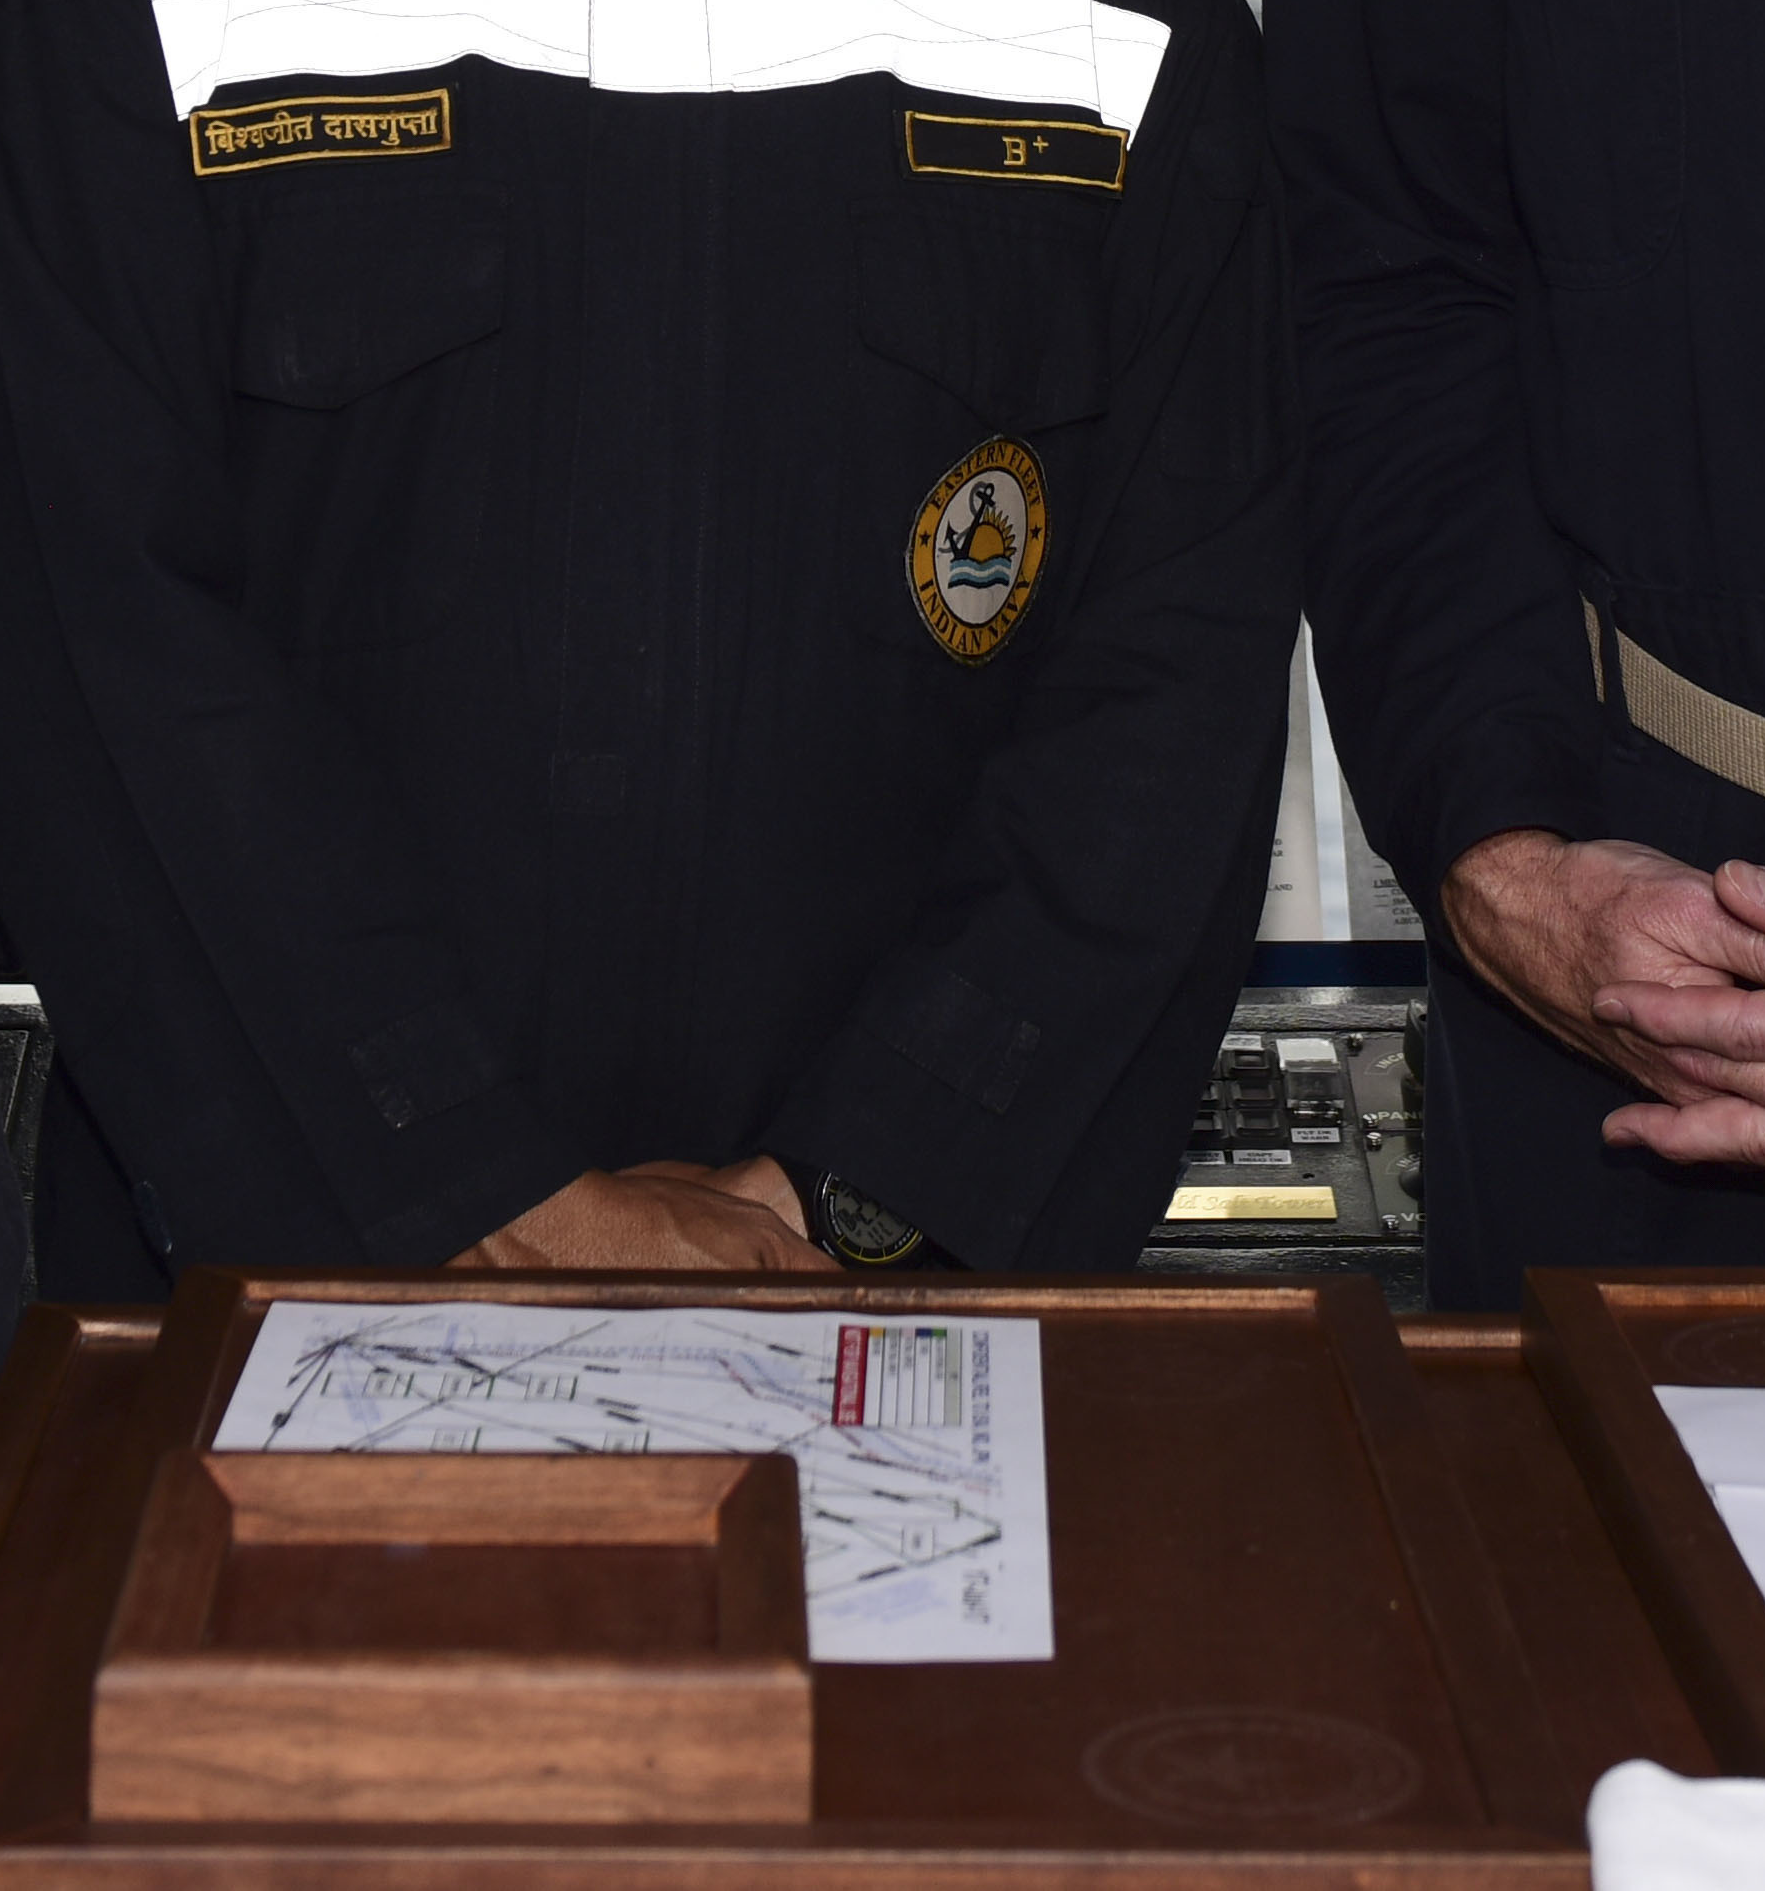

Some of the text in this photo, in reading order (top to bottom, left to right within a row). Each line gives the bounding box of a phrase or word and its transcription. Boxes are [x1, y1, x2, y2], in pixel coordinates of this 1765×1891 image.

[929, 443, 1043, 512] EASTERN FLEET
[918, 577, 984, 655] INDIAN
